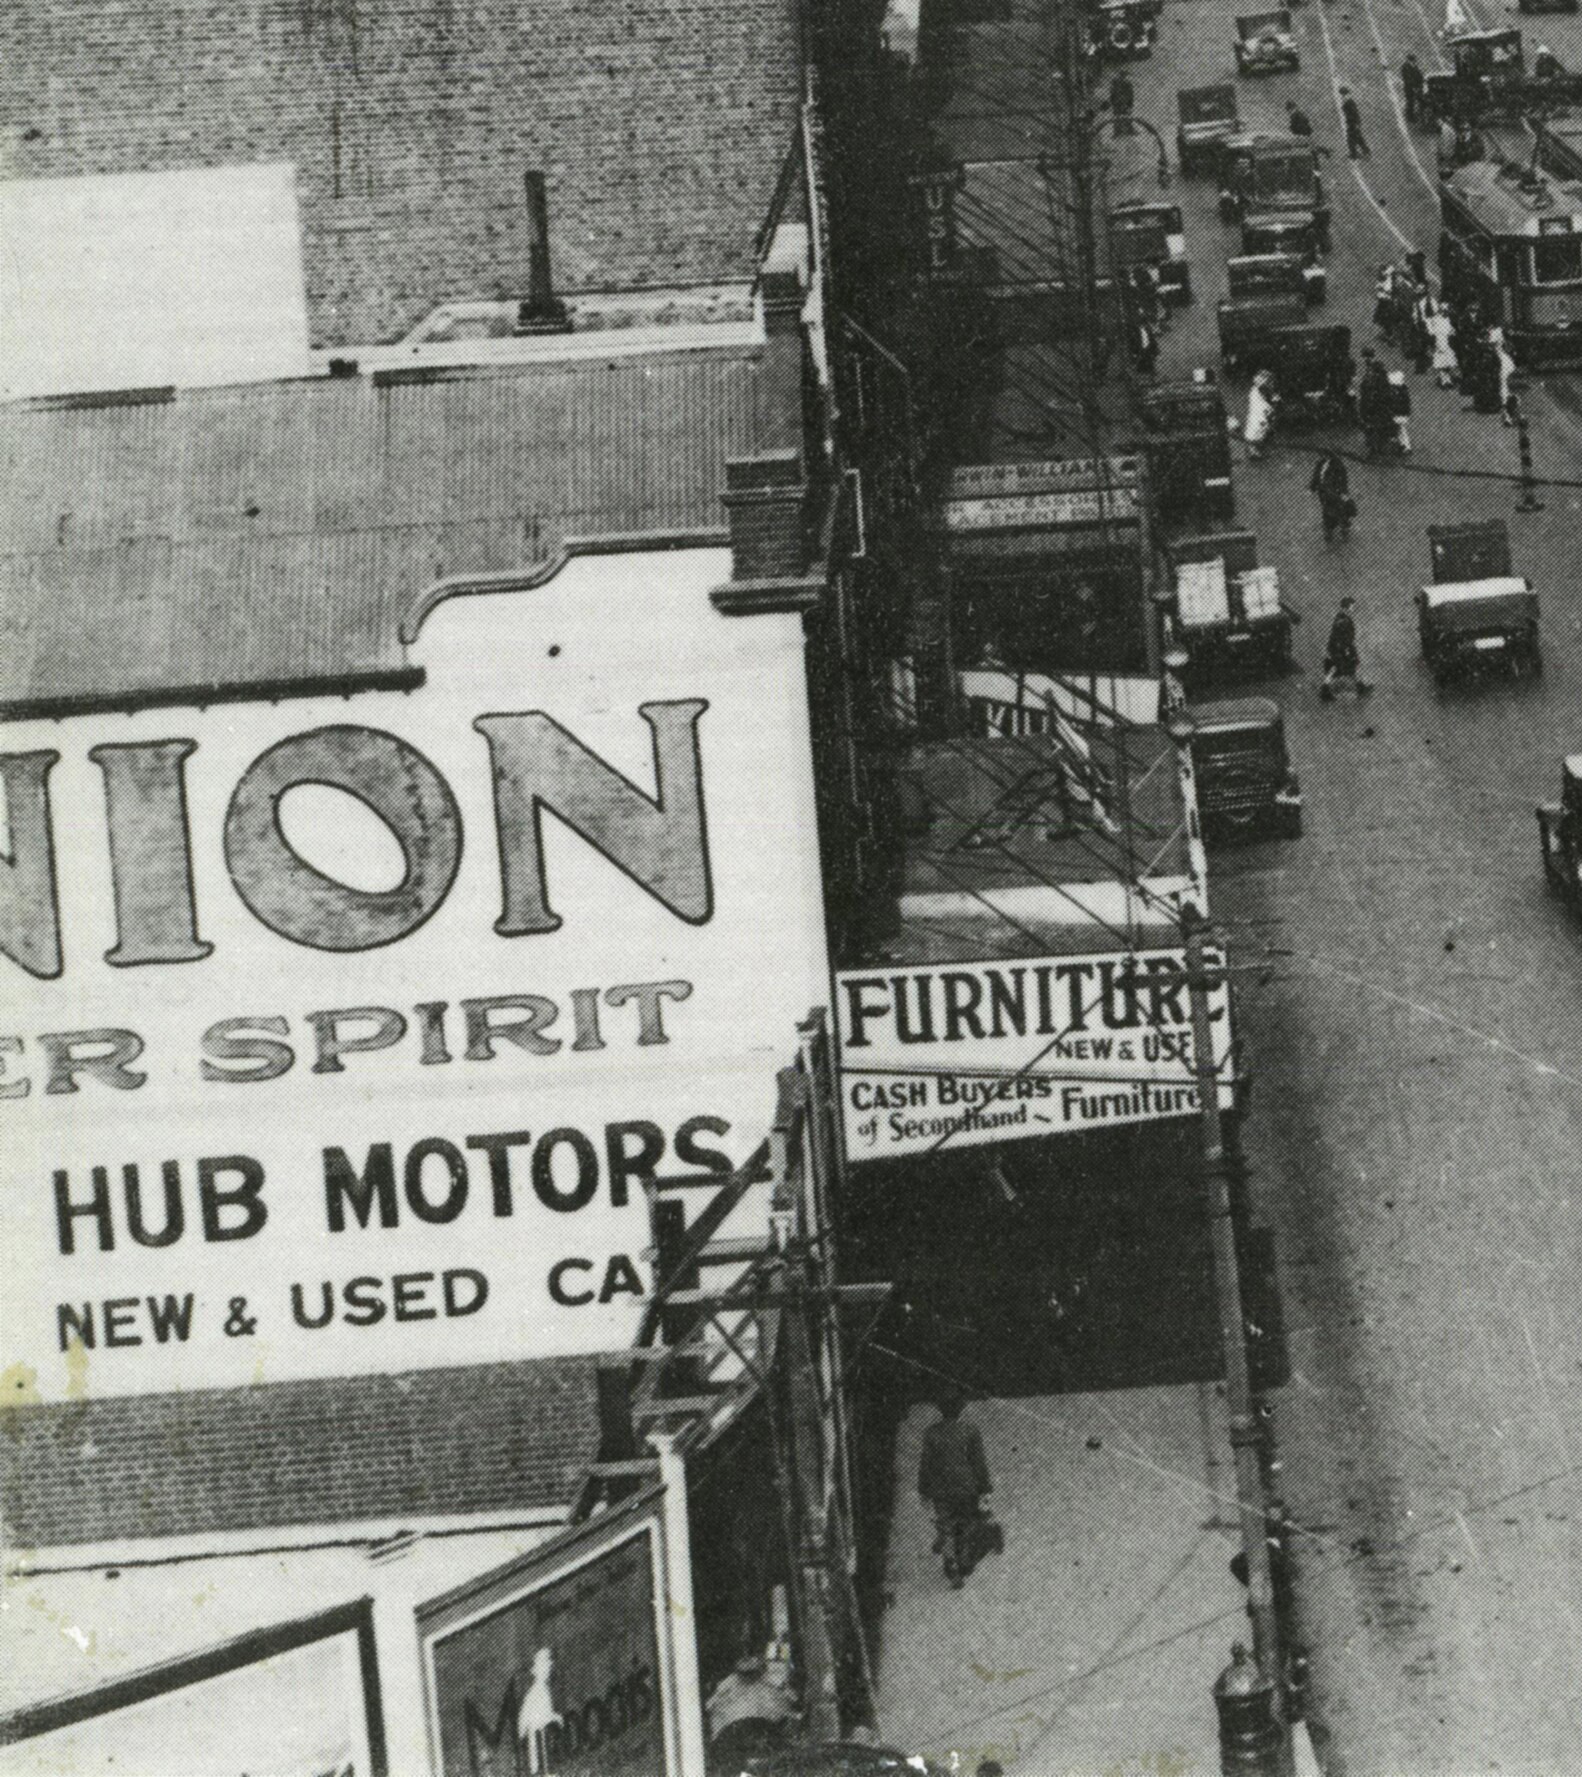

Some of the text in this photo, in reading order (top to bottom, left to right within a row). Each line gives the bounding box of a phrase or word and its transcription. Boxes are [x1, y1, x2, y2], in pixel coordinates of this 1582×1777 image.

[200, 979, 694, 1084] SPIRIT
[841, 953, 1226, 1049] FURNITURE
[1055, 1030, 1197, 1063] NEW & USE
[857, 1114, 879, 1147] of
[1061, 1084, 1203, 1123] Furniture
[52, 1114, 735, 1256] HUB MOTORS
[57, 1292, 195, 1353] NEW
[223, 1296, 259, 1338] &
[290, 1267, 490, 1330] USED
